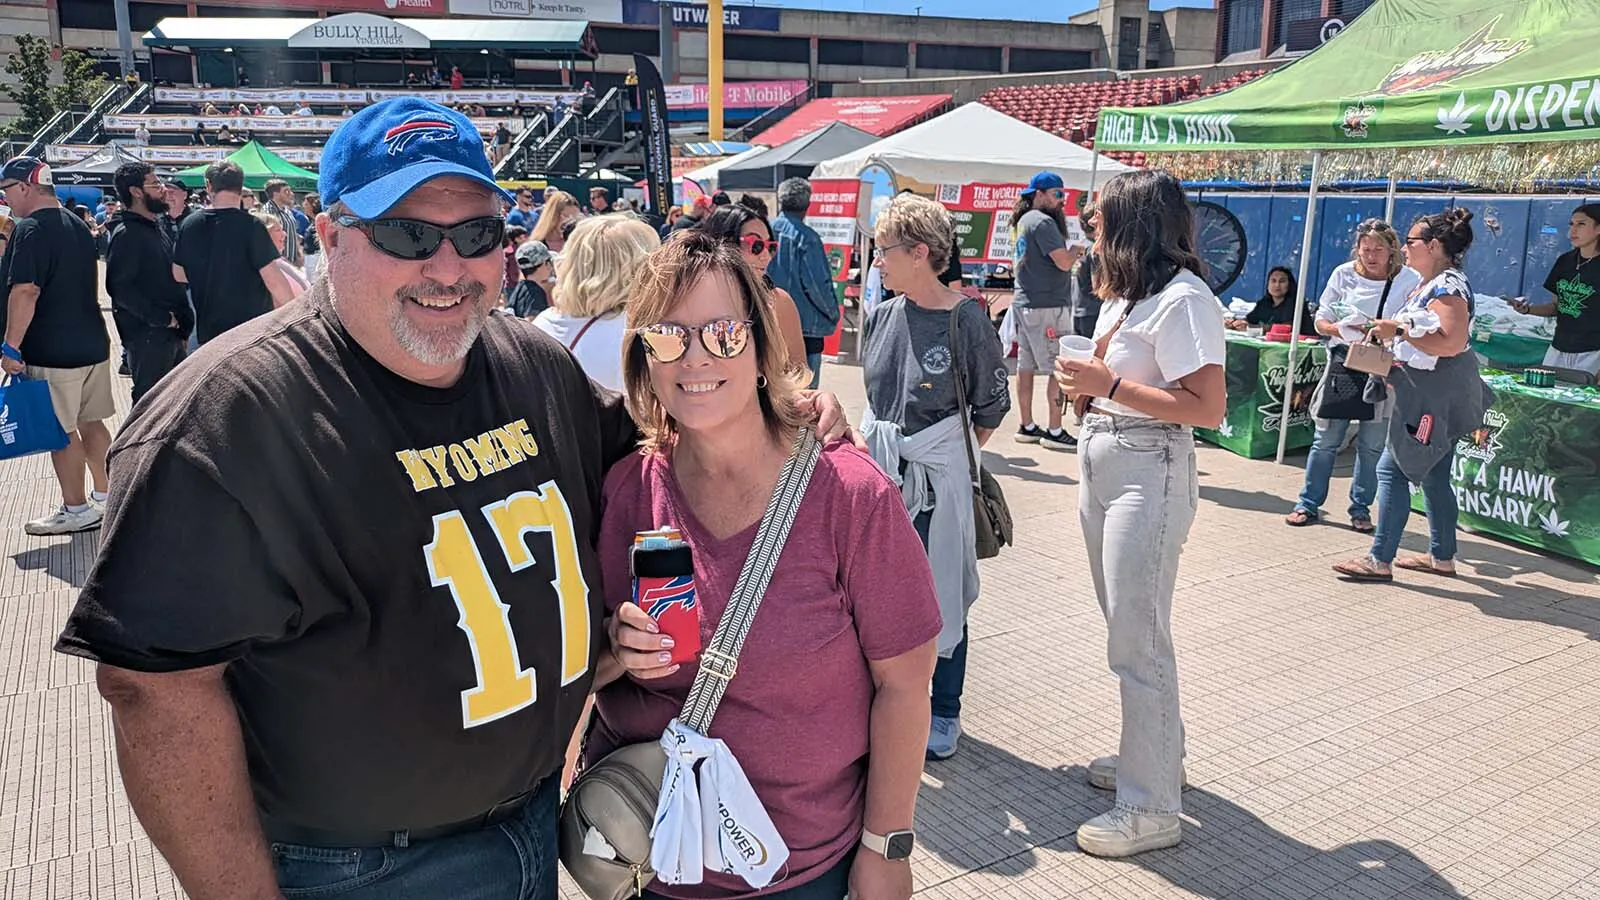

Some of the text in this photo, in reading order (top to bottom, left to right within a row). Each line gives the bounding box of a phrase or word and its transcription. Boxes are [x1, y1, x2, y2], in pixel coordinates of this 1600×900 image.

[539, 3, 557, 13] Keep
[672, 7, 741, 25] UTWAER
[314, 26, 402, 39] BULLY HILL
[355, 37, 404, 46] VINEYARDS
[744, 84, 792, 104] Mobile
[651, 98, 659, 132] GUARD
[1102, 114, 1238, 144] HIGH AS A HAWK
[655, 132, 665, 184] NATIONAL
[973, 186, 990, 200] THE
[395, 418, 539, 493] WYOMING
[1473, 462, 1487, 488] A
[1498, 465, 1556, 504] HAWK
[1454, 484, 1533, 528] ENSARY
[422, 479, 591, 729] 17
